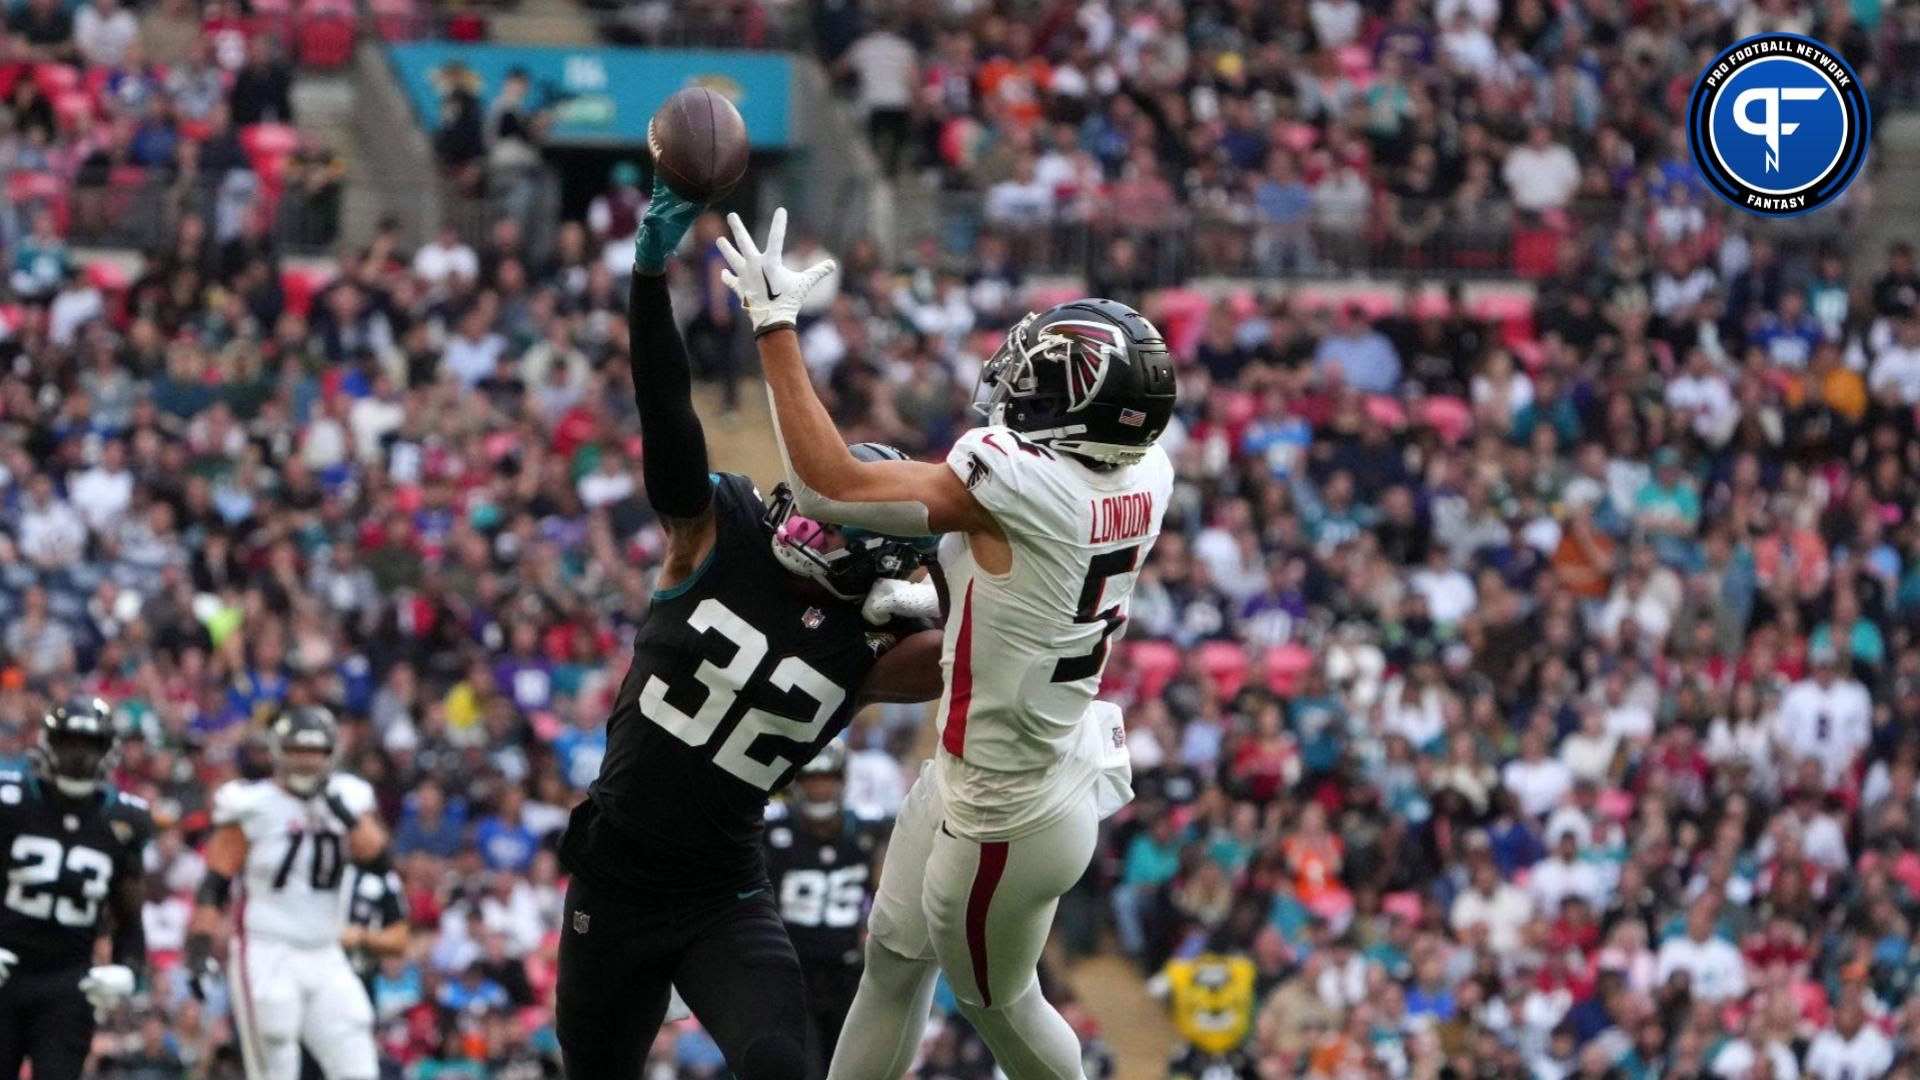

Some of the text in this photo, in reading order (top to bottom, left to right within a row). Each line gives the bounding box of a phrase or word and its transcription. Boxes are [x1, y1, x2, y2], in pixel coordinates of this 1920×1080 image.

[1089, 491, 1152, 544] LONDON
[1050, 544, 1140, 683] 5
[638, 598, 846, 791] 32
[5, 834, 113, 928] 23
[274, 830, 342, 890] 70
